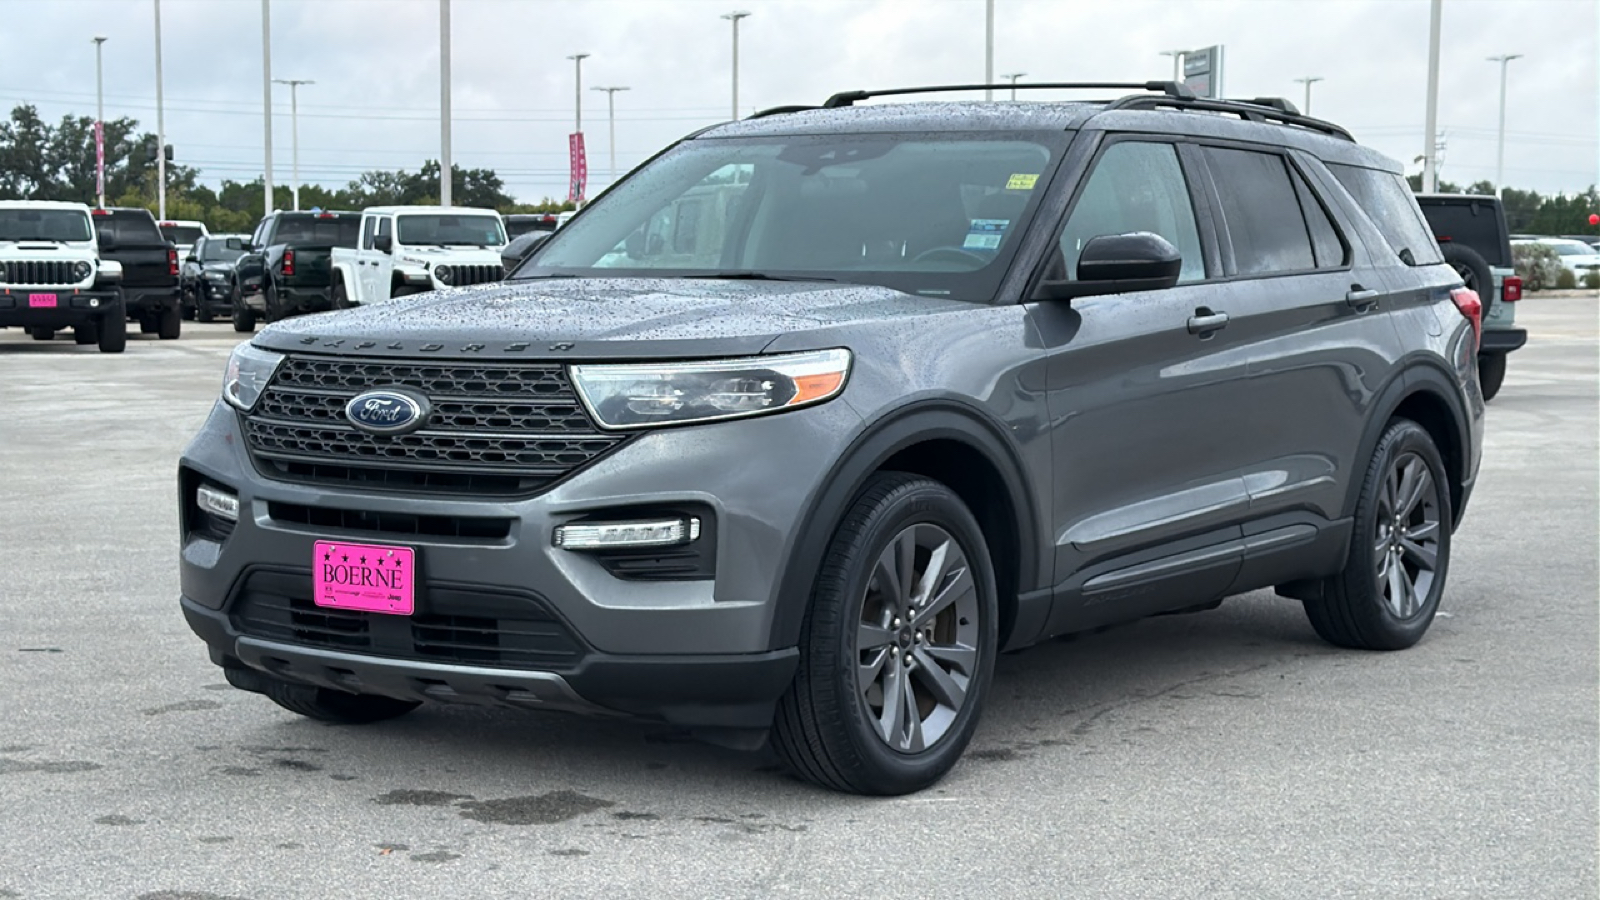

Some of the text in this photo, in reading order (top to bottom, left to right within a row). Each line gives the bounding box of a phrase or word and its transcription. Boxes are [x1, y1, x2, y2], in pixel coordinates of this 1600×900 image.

[300, 337, 576, 352] EXPLORER
[360, 398, 401, 422] Ford
[323, 563, 404, 590] BOERNE
